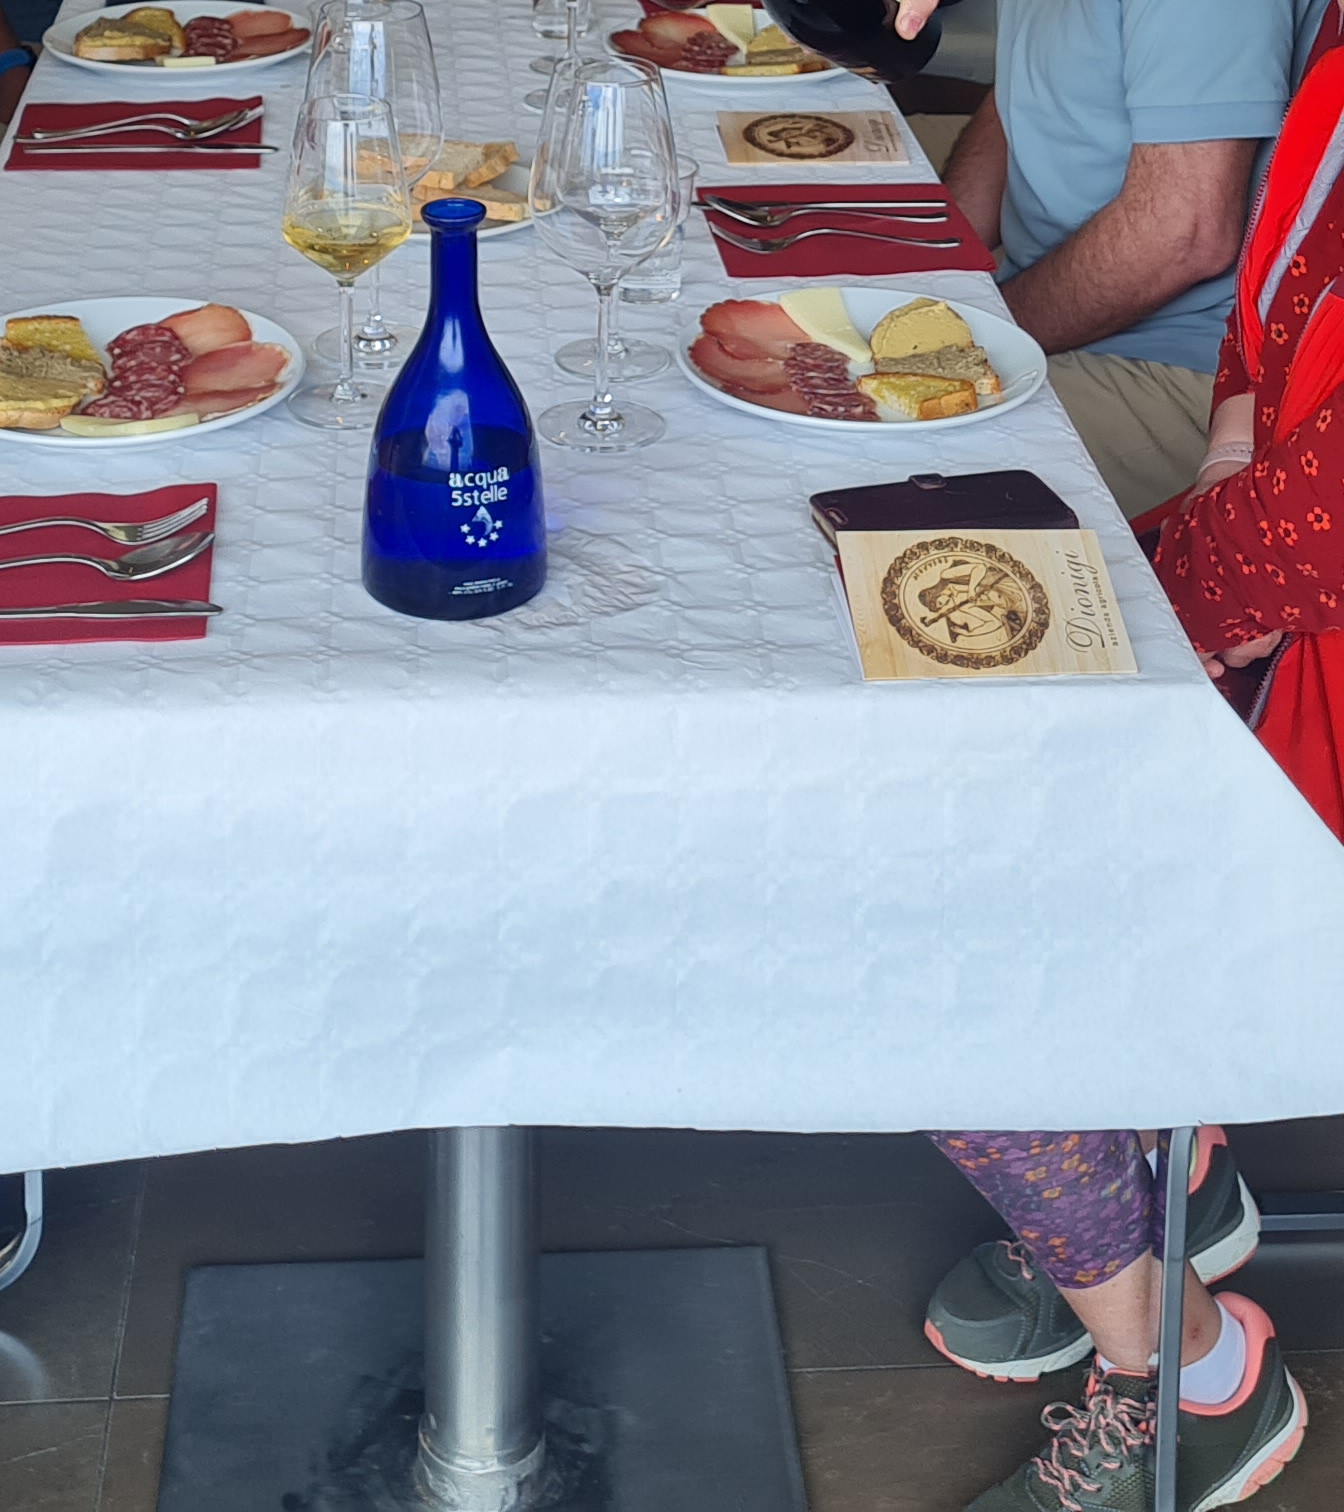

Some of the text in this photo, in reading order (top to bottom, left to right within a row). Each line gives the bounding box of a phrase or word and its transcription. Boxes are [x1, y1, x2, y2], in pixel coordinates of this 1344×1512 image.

[448, 466, 510, 489] acqua
[450, 485, 508, 507] 5stelle
[1056, 549, 1105, 653] Dionigi
[1093, 576, 1118, 646] azienda agricola
